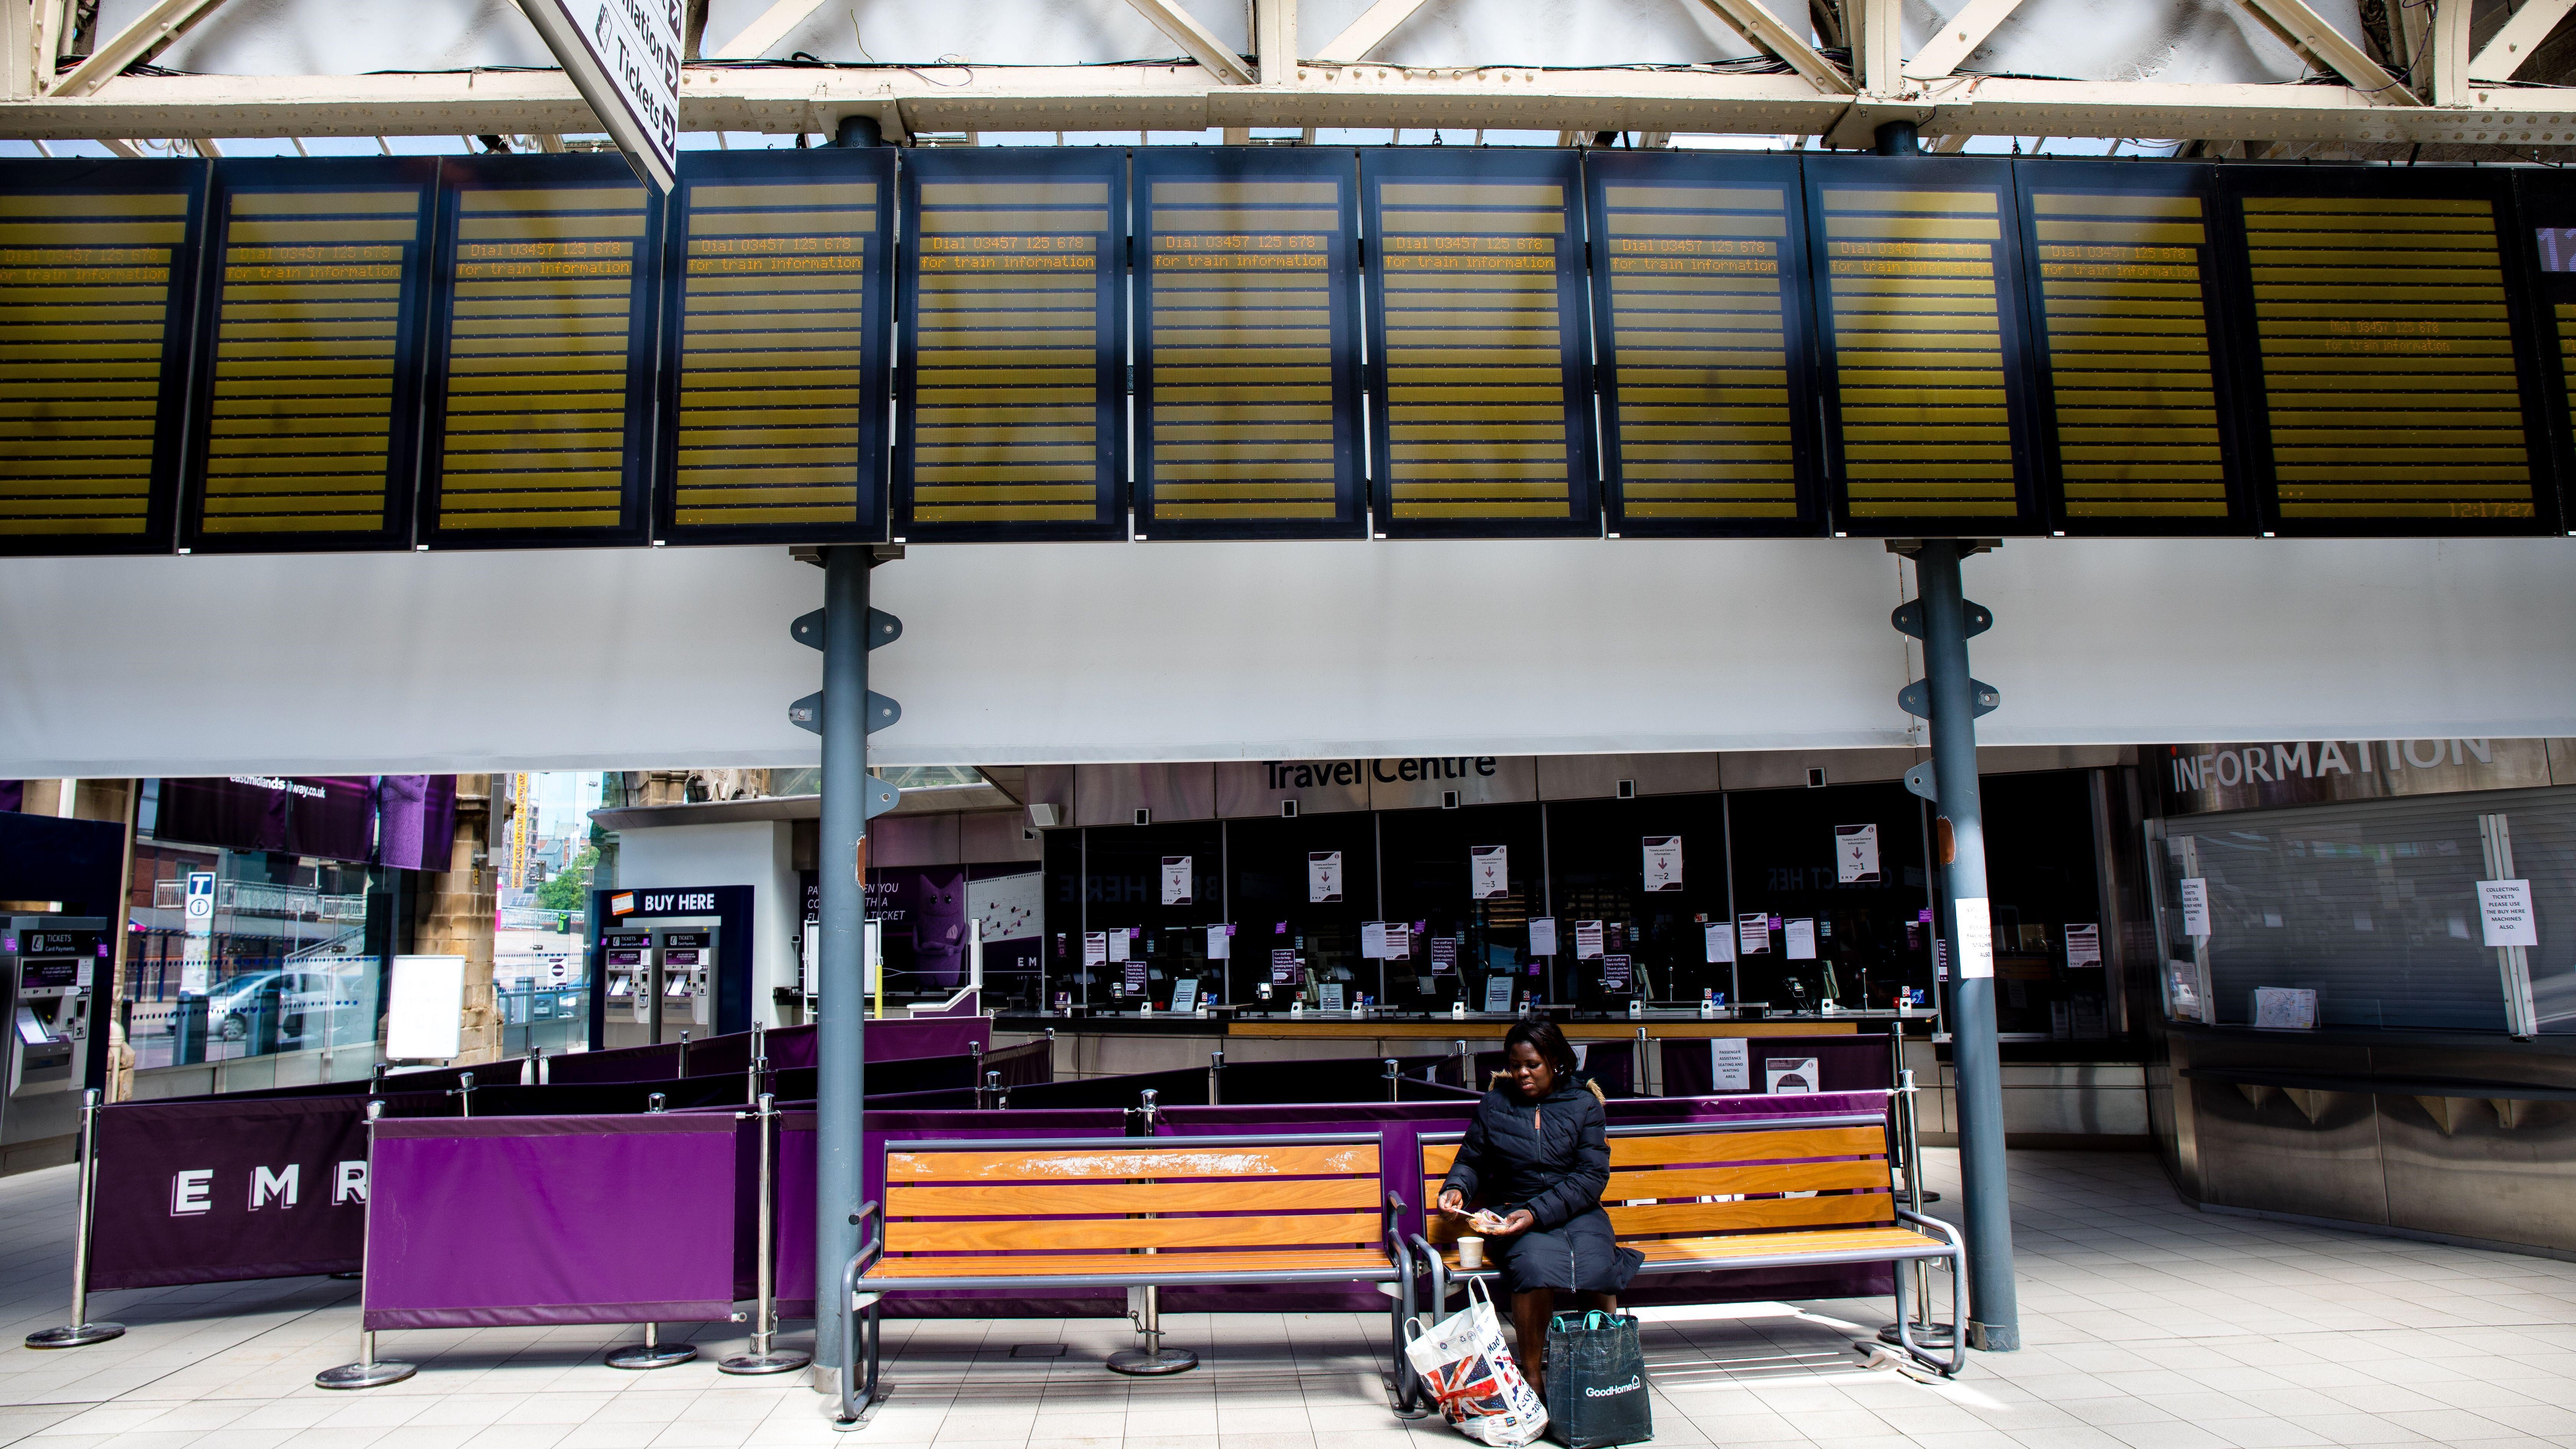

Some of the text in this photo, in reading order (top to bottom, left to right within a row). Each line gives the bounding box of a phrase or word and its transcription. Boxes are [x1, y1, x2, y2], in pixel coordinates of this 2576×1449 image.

[618, 34, 660, 130] Tickets
[702, 237, 851, 251] Dial 03457 125 678
[934, 237, 1083, 249] Dial 03457 125 678
[1166, 235, 1315, 248] Dial 03457 125 678
[1396, 237, 1543, 250] Dial 03457 125 678
[1622, 239, 1765, 253] Dial 03457 125 678
[470, 242, 620, 256] Dial 03457 125 678
[689, 256, 861, 270] for train information
[922, 256, 1094, 268] for train information
[1155, 254, 1327, 267] for train information
[1386, 256, 1554, 268] for train information
[1613, 258, 1776, 271] for train information
[459, 261, 629, 275] for train information
[2172, 739, 2493, 792] INFORMATION
[1262, 756, 1496, 789] Travel Centre
[808, 886, 819, 895] PA
[645, 893, 715, 911] BUY HERE
[882, 897, 888, 906] A
[871, 910, 905, 920] TICKET
[1585, 1384, 1632, 1397] GoodHome
